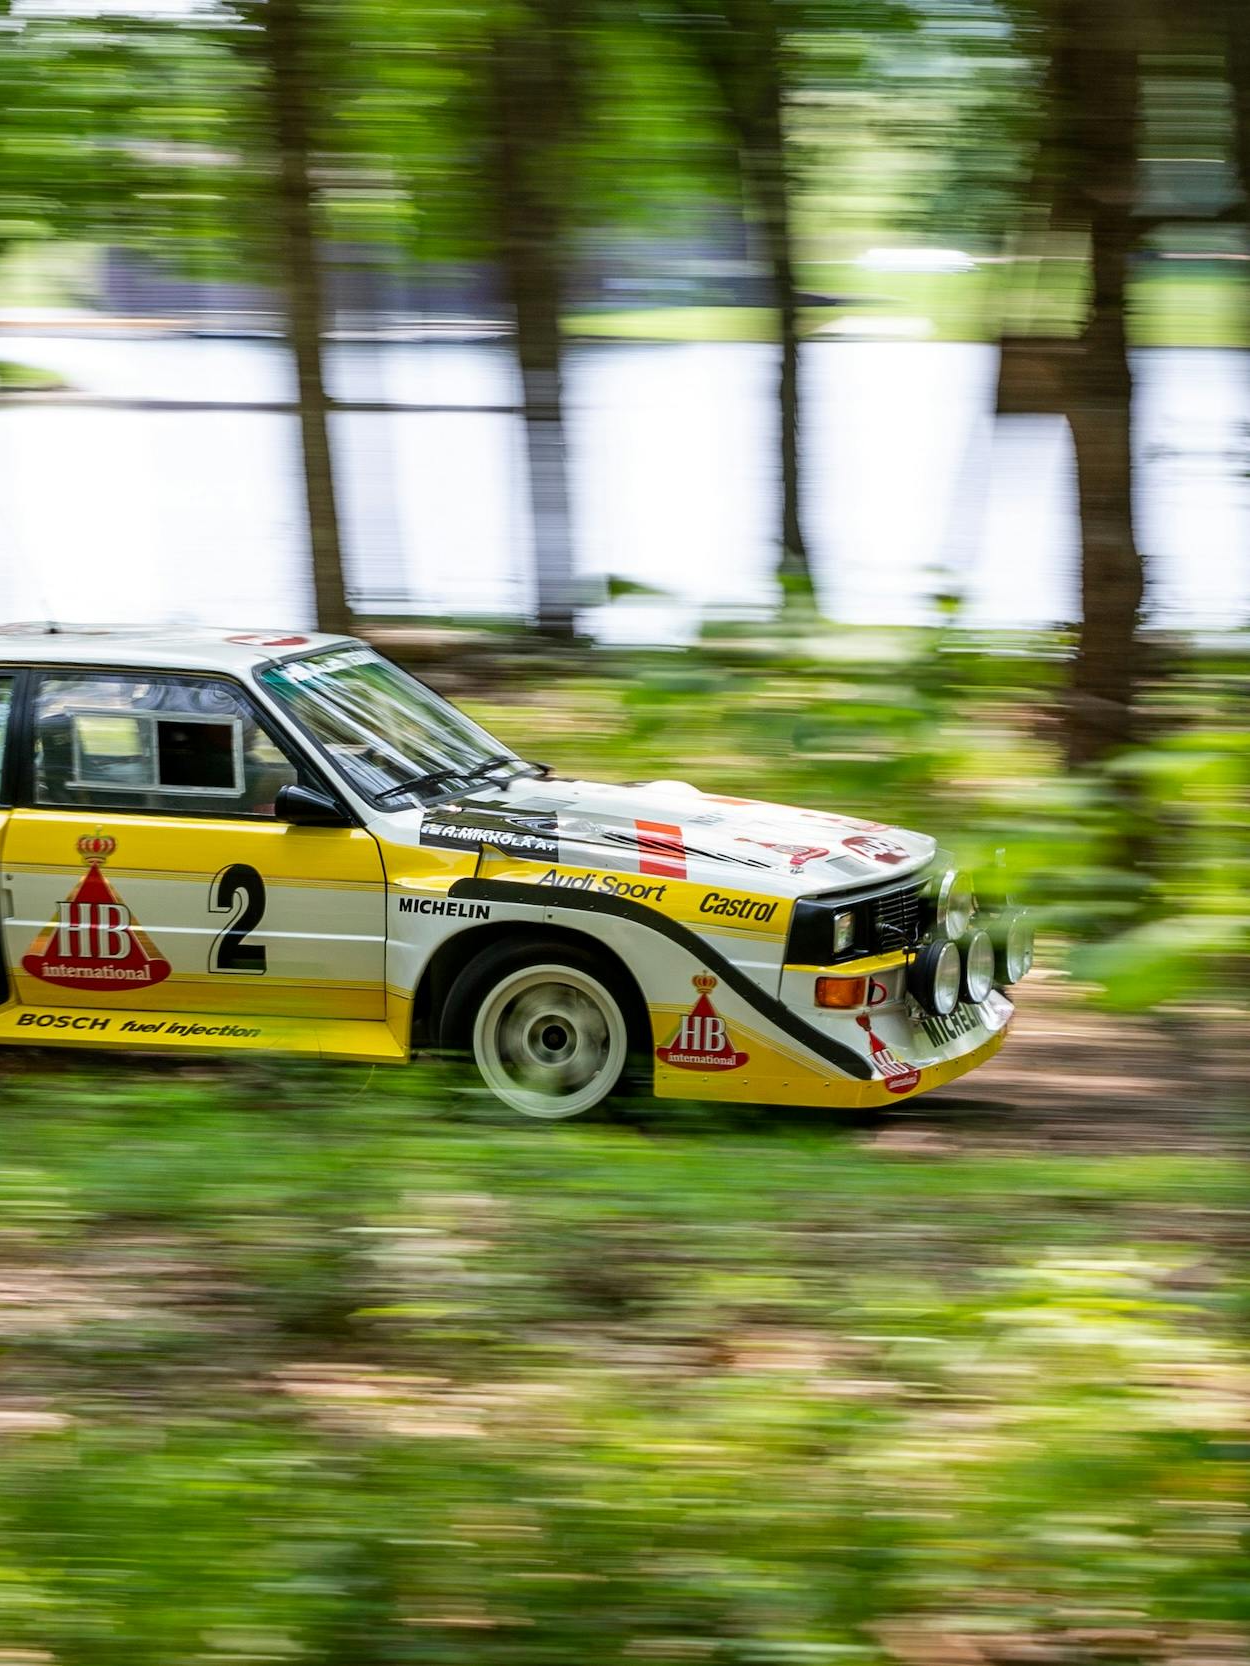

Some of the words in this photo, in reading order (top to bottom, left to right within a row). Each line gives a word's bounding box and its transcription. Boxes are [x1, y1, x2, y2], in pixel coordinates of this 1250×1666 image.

[538, 869, 597, 891] Audi
[598, 876, 667, 902] Sport
[208, 863, 267, 975] 2
[399, 898, 491, 920] MICHELIN
[699, 893, 779, 922] Castrol
[56, 901, 133, 960] HB
[41, 963, 152, 981] international
[16, 1013, 111, 1031] BOSCH
[119, 1020, 165, 1033] fuel
[165, 1021, 261, 1038] injection
[679, 1015, 727, 1052] HB
[667, 1052, 737, 1066] international
